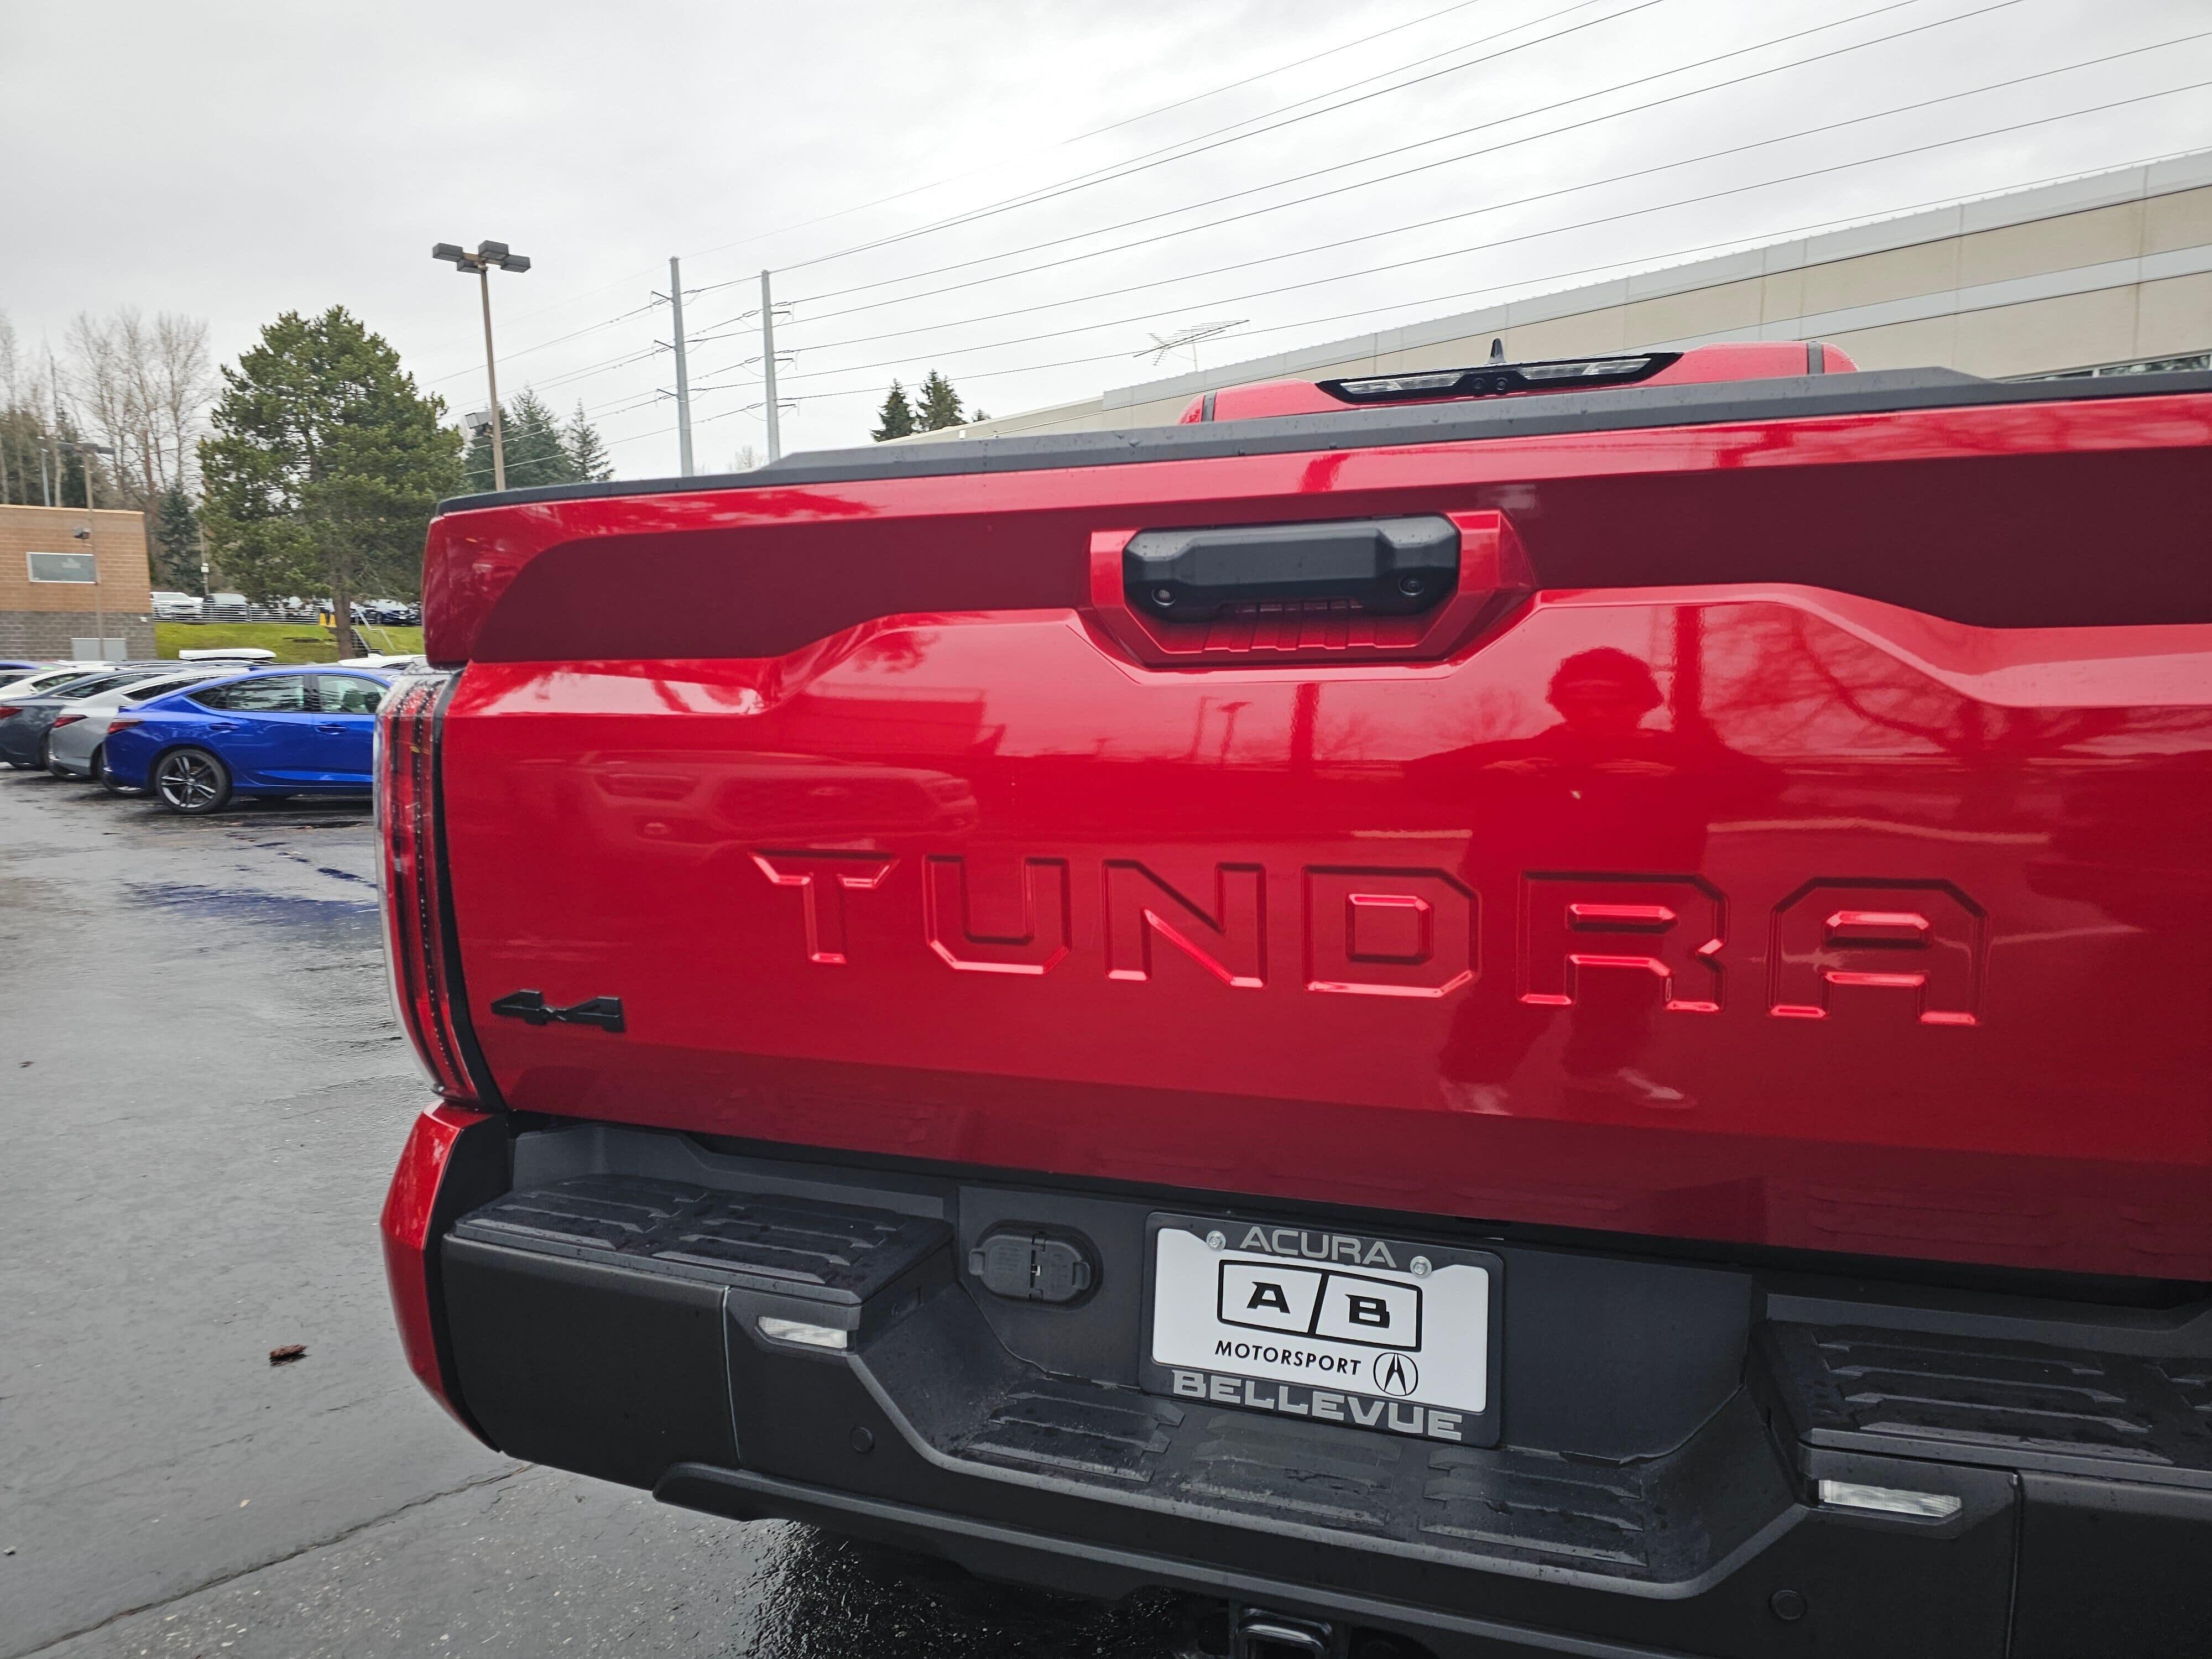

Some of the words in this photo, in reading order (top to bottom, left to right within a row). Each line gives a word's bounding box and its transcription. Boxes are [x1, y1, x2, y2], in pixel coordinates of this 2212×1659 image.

[752, 851, 1988, 1025] TUNDRA
[1240, 1226, 1396, 1268] ACURA
[1246, 1281, 1290, 1313] A
[1345, 1294, 1390, 1328] B
[1215, 1340, 1361, 1376] MOTORSPORT
[1171, 1370, 1463, 1441] BELLEVUE
